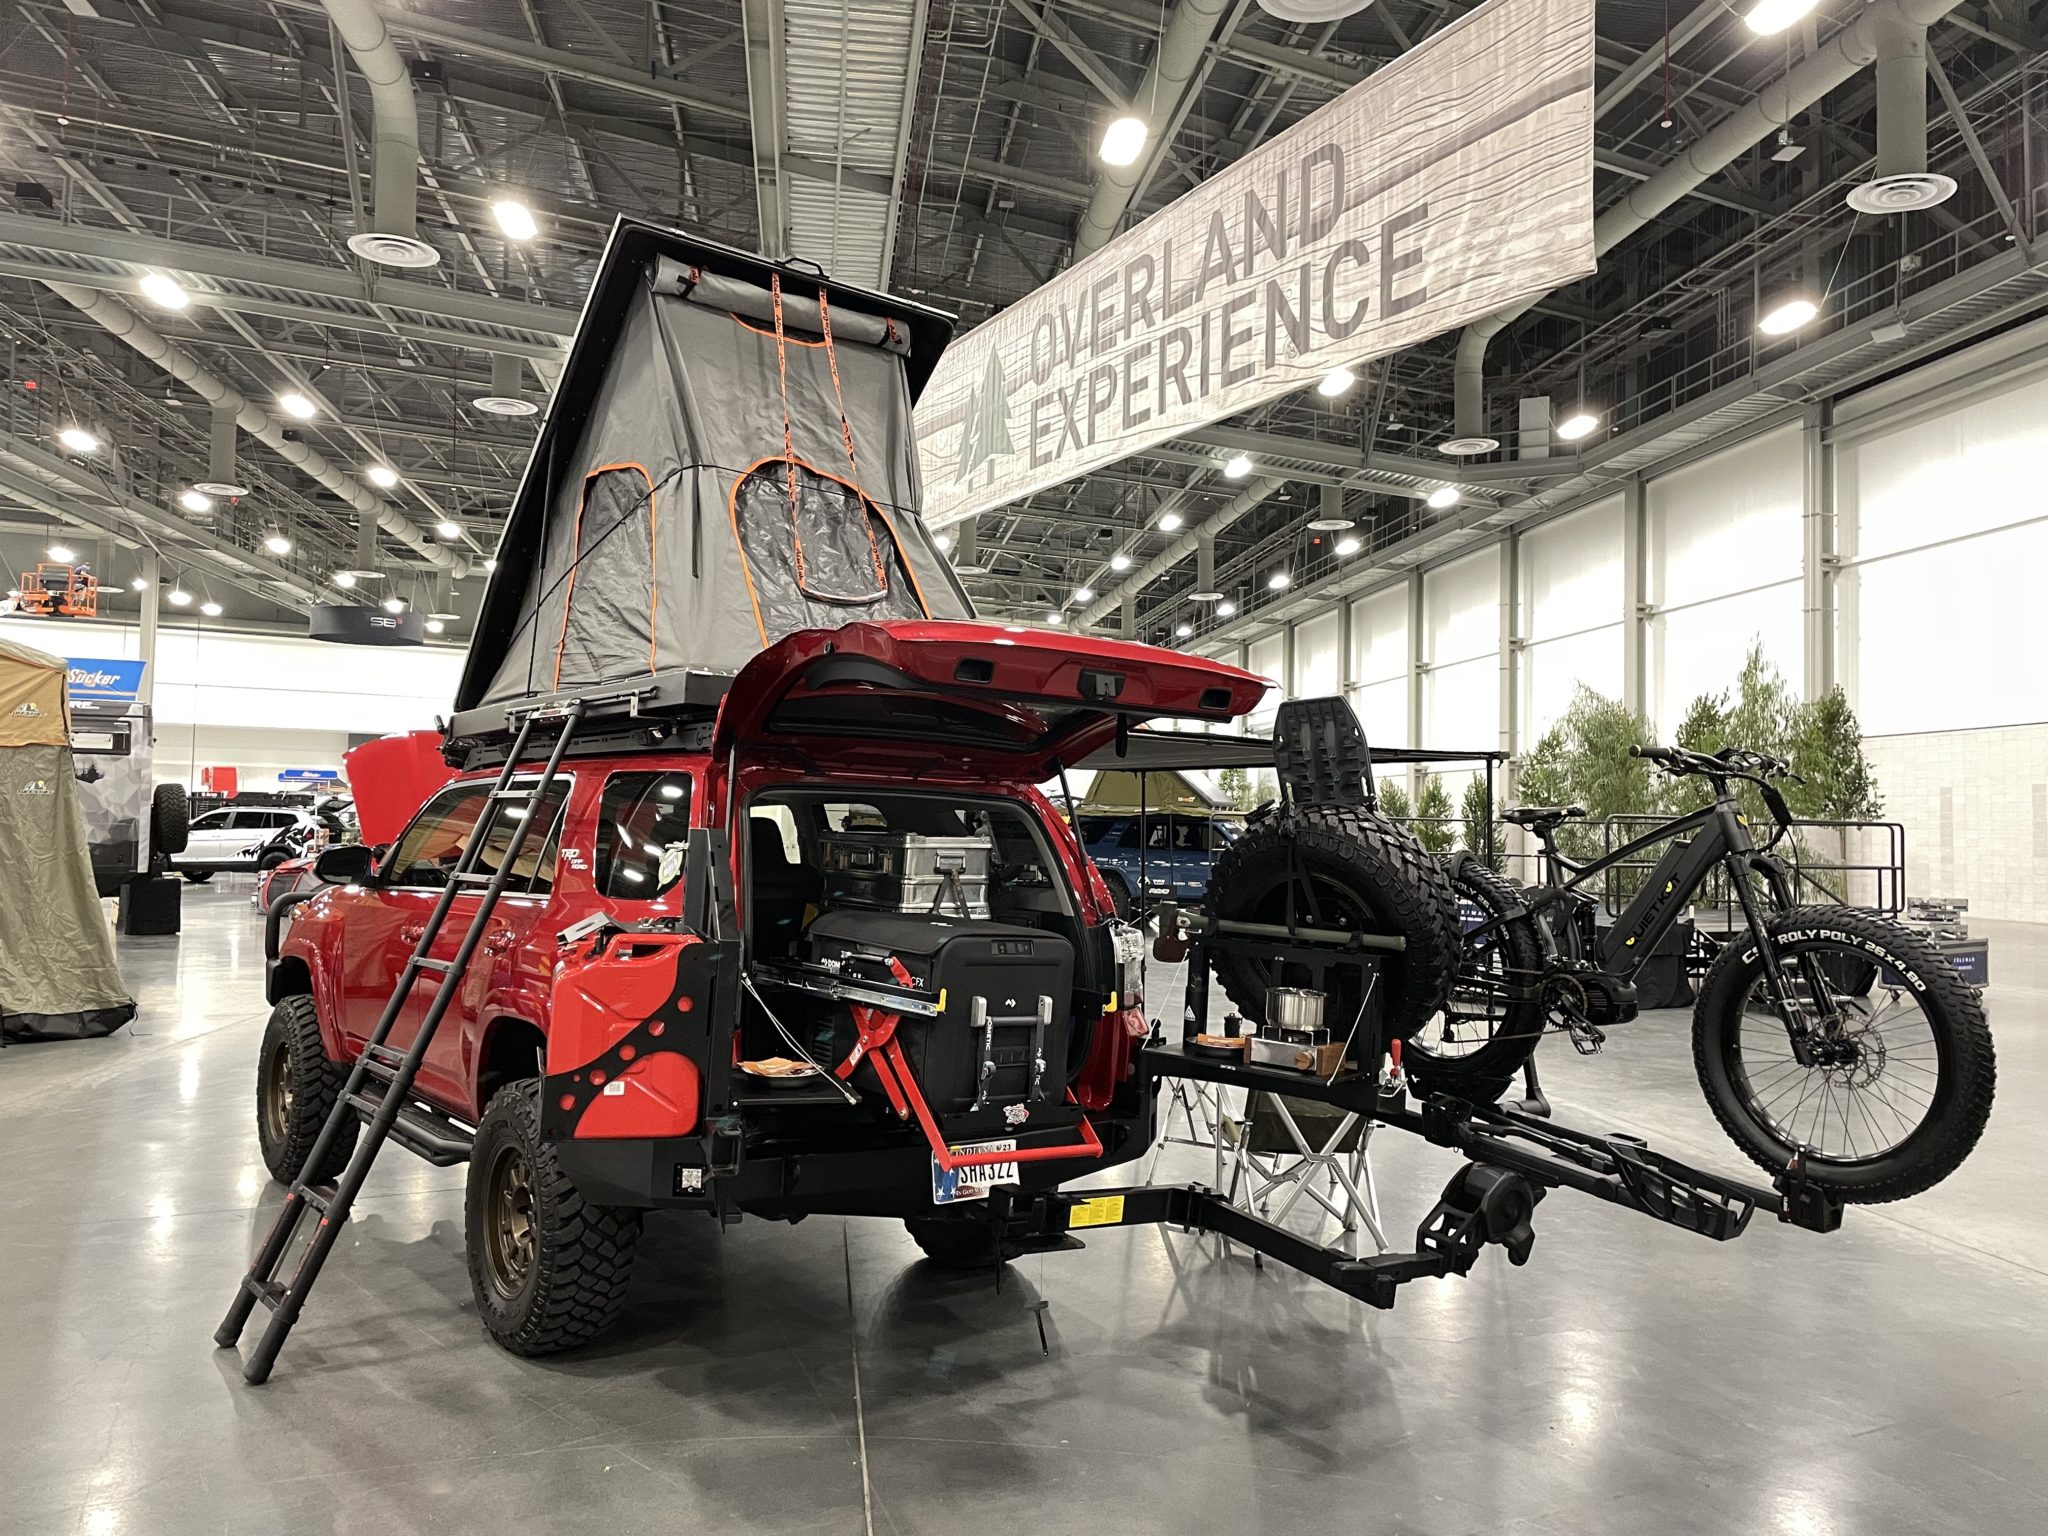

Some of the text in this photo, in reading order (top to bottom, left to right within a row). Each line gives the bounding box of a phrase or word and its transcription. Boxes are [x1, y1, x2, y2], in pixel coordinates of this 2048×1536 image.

[1029, 141, 1347, 387] OVERLAND
[1028, 201, 1430, 470] EXPERIENCE
[561, 848, 580, 861] TRD
[1777, 928, 1818, 945] ROLY
[1819, 928, 1864, 946] POLY
